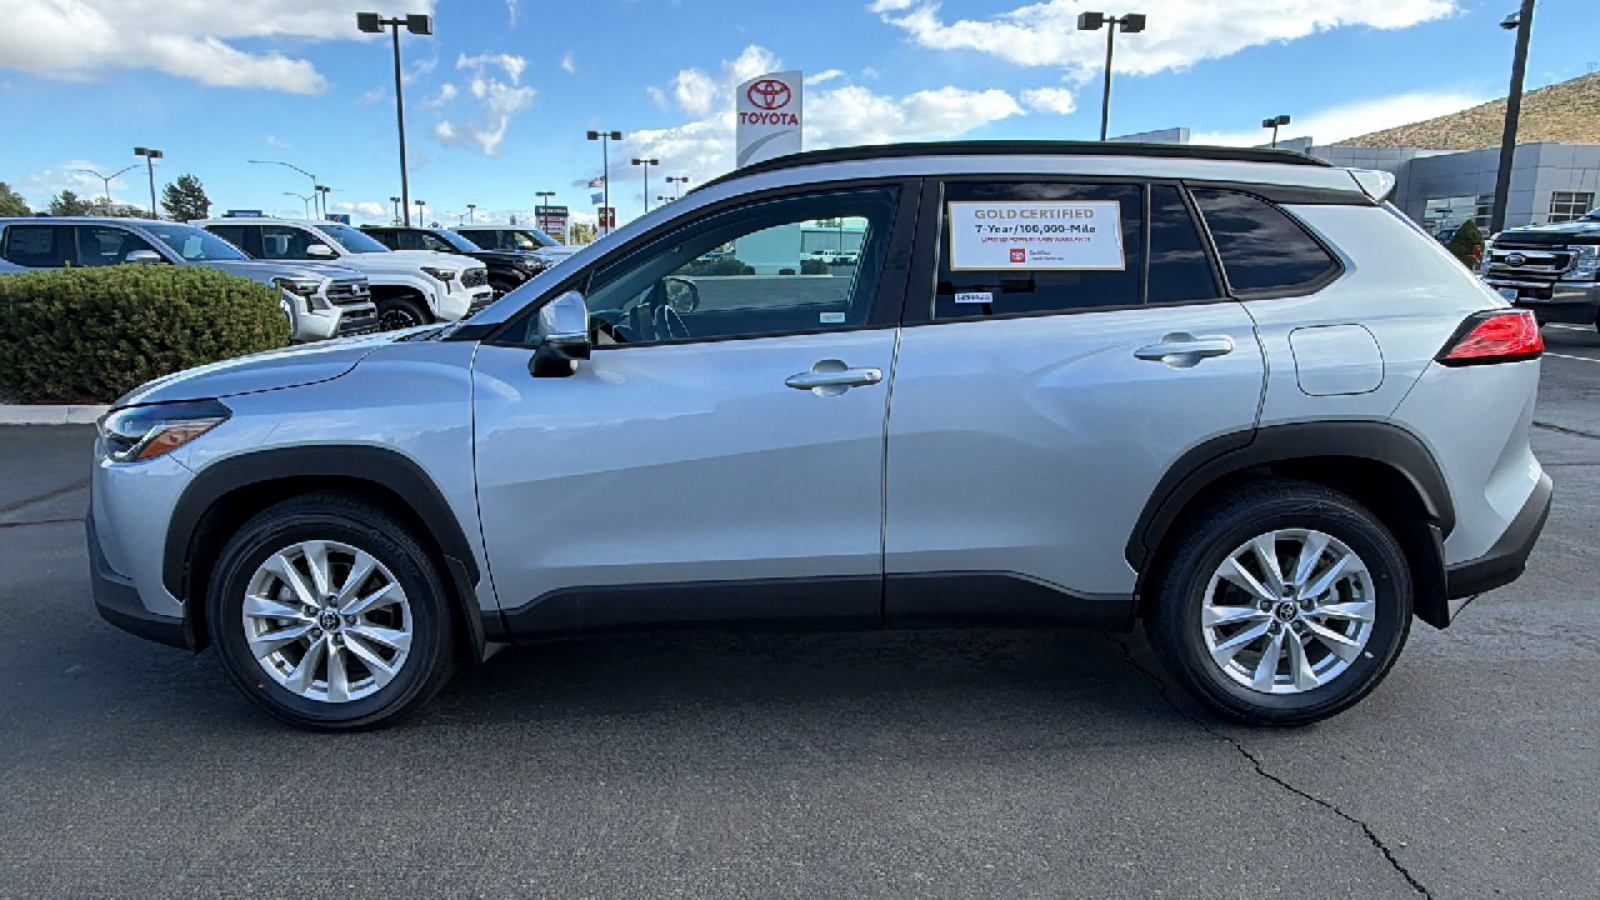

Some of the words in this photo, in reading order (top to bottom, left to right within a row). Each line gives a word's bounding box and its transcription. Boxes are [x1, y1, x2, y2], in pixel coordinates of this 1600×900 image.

[740, 112, 799, 125] TOYOTA
[974, 209, 1017, 220] GOLD
[1020, 208, 1095, 219] CERTIFIED
[974, 224, 1096, 235] 7-Year/100,000-Mile
